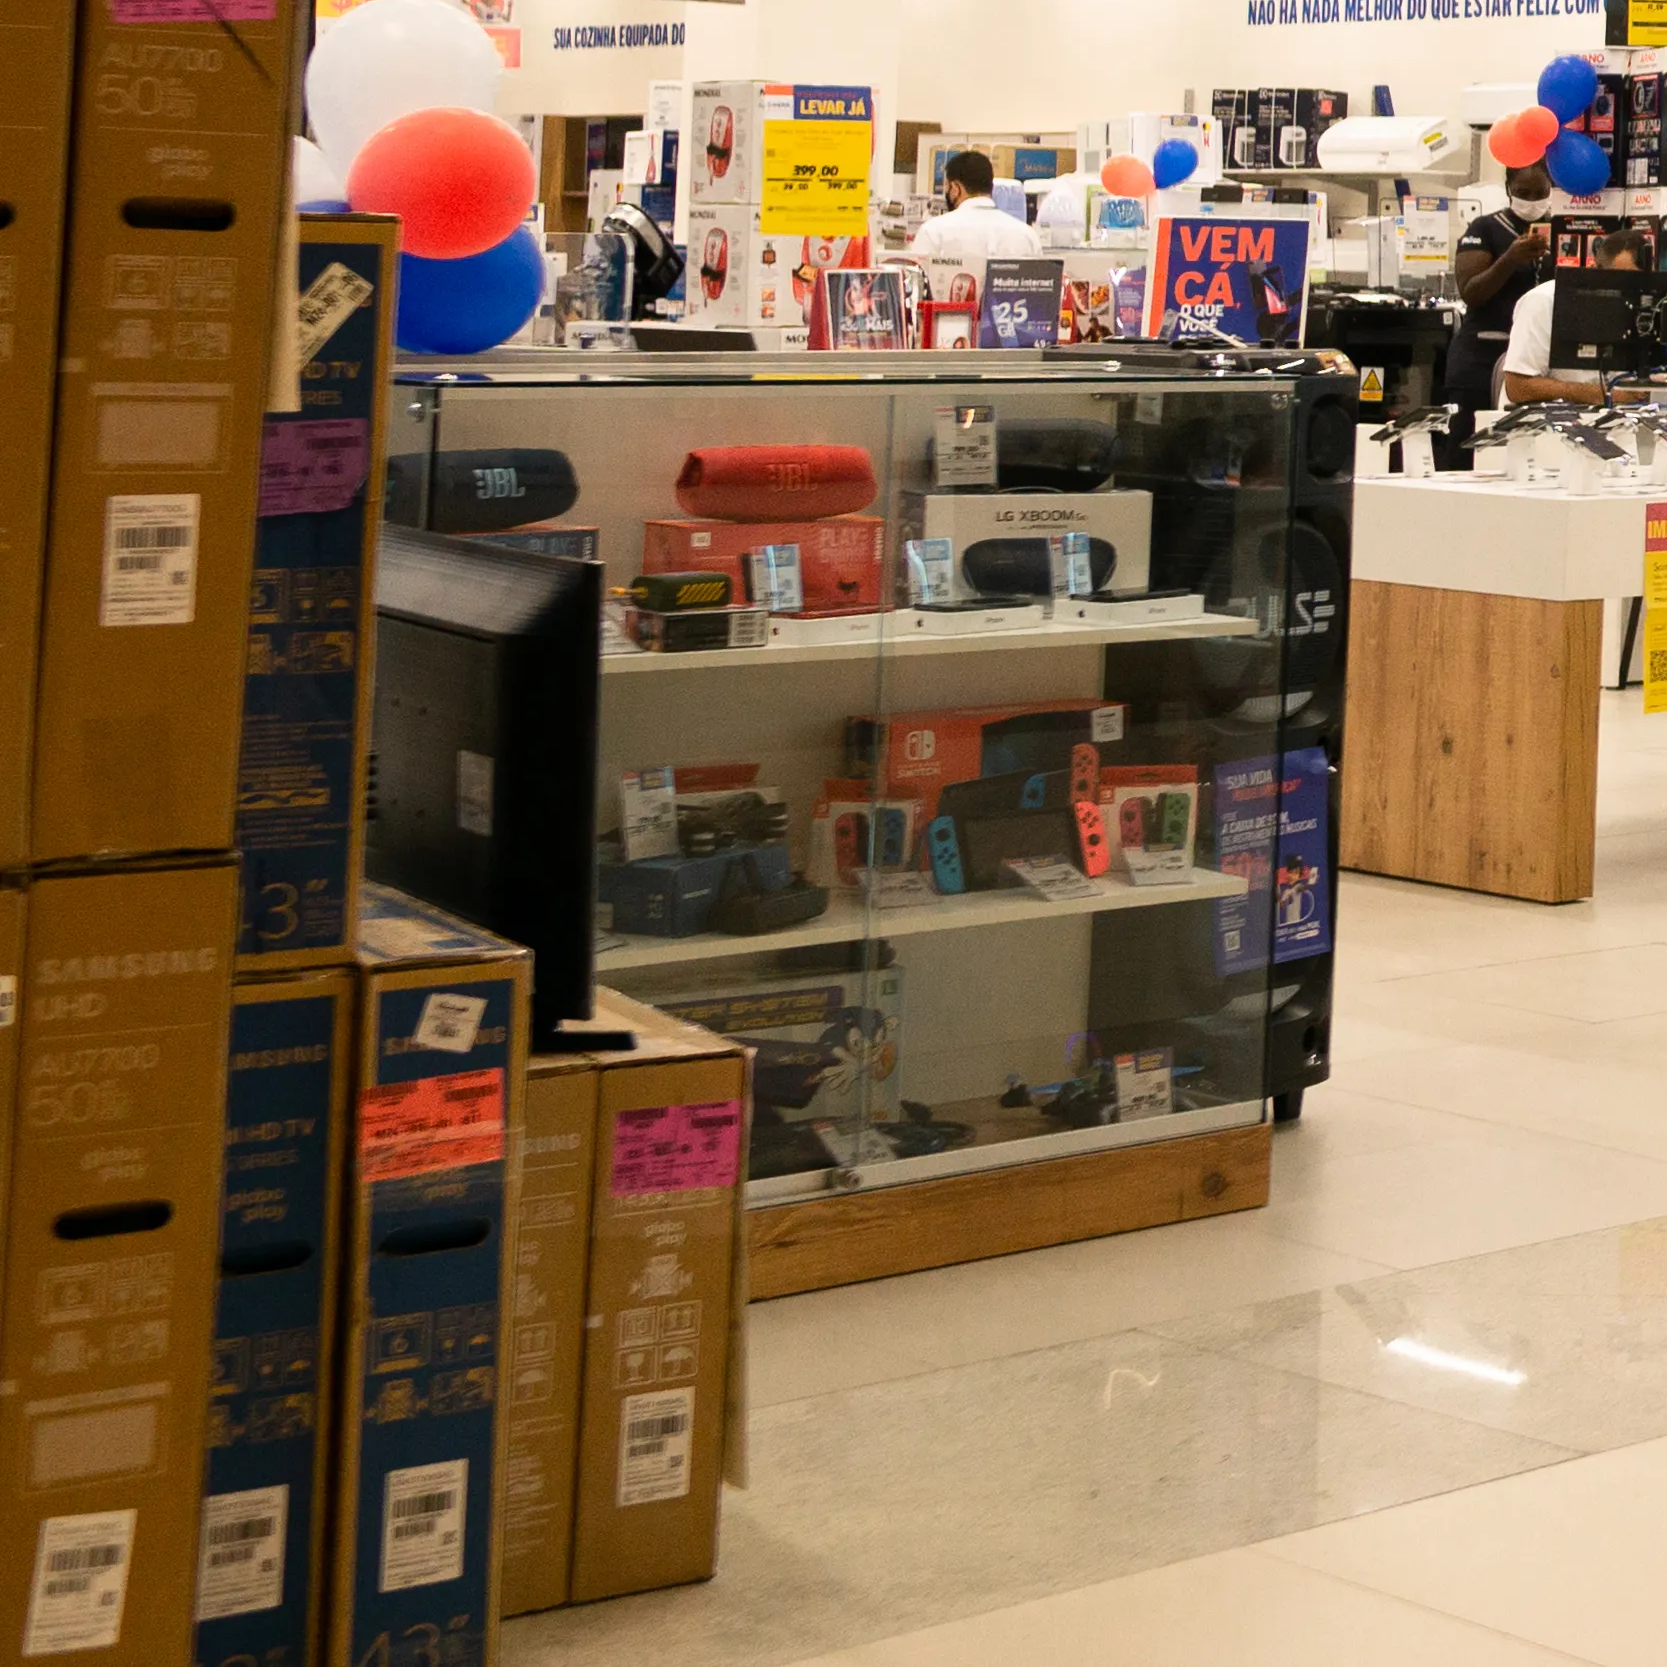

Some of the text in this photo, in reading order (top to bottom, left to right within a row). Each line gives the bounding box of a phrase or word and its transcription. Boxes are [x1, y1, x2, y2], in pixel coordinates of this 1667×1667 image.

[553, 22, 686, 50] SUA COZINHA EQUIPADA DO
[799, 96, 866, 116] LEVAR JÁ
[1179, 225, 1275, 263] VEM
[1021, 277, 1055, 289] internet
[1174, 261, 1242, 310] CÁ,
[1180, 303, 1224, 318] O QUE
[994, 508, 1076, 523] LG XBOOM
[36, 946, 219, 984] SAMSUNG
